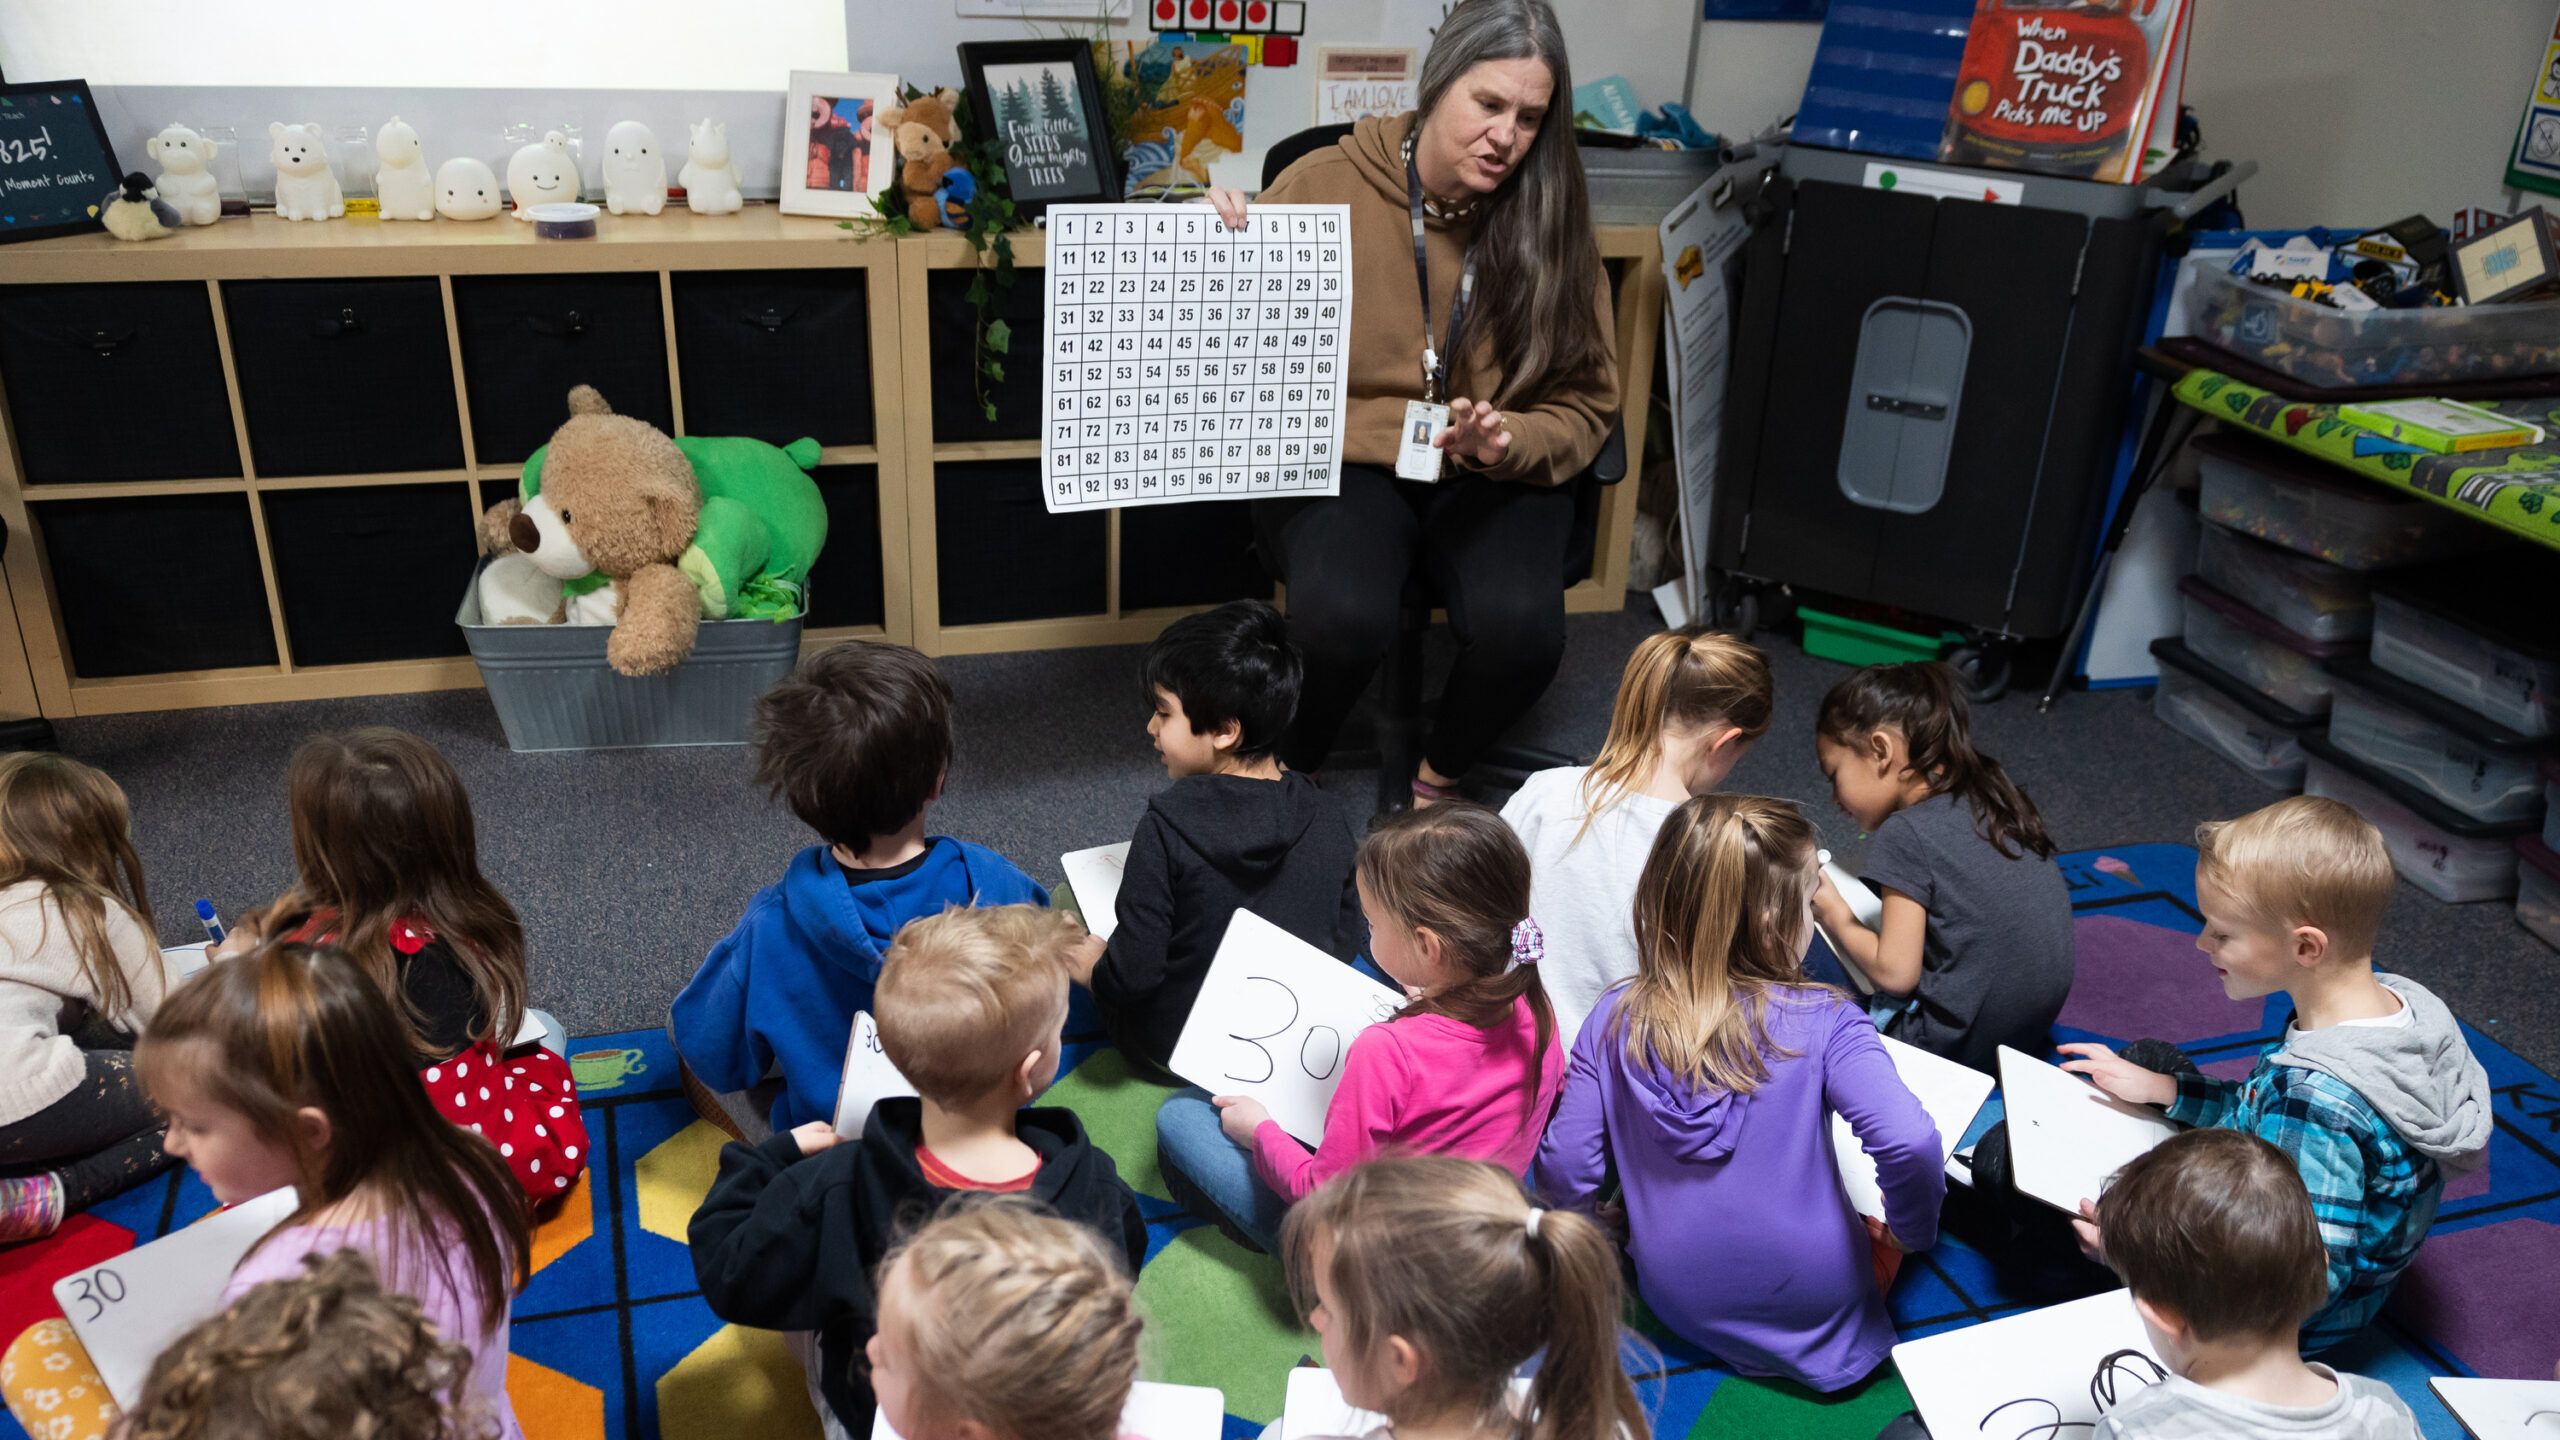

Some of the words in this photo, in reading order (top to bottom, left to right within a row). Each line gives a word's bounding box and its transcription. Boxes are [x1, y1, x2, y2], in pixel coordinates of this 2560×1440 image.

[2017, 16, 2067, 40] When
[2013, 40, 2122, 84] Daddy's
[2017, 72, 2106, 110] Truck
[1992, 98, 2034, 126] Picks
[1024, 134, 1060, 153] SEEDS
[5, 174, 51, 191] Moment
[1028, 166, 1065, 186] TREES
[1066, 221, 1072, 235] 1
[1095, 221, 1103, 234] 2
[1126, 220, 1134, 234] 3
[1156, 220, 1165, 234] 4
[1187, 220, 1194, 234] 5
[1215, 220, 1223, 234] 6
[1271, 221, 1278, 233] 8
[1299, 221, 1306, 233] 9
[1322, 221, 1335, 233] 10
[1062, 251, 1075, 265] 11
[1090, 250, 1106, 264] 12
[1121, 250, 1137, 264] 13
[1152, 250, 1167, 263] 14
[1182, 250, 1197, 263] 15
[1211, 250, 1226, 263] 16
[1239, 250, 1254, 263] 17
[1269, 249, 1283, 262] 18
[1297, 249, 1311, 262] 19
[1323, 249, 1337, 262] 20
[1061, 281, 1075, 295] 21
[1089, 280, 1105, 294] 22
[1119, 280, 1136, 293] 23
[1150, 279, 1166, 293] 24
[1180, 279, 1195, 292] 25
[1209, 279, 1224, 292] 26
[1237, 279, 1253, 292] 27
[1267, 278, 1282, 292] 28
[1296, 278, 1311, 291] 29
[1323, 278, 1337, 291] 30
[1060, 311, 1074, 325] 31
[1088, 310, 1104, 324] 32
[1118, 309, 1134, 322] 33
[1149, 308, 1164, 322] 34
[1178, 308, 1194, 321] 35
[1207, 308, 1222, 321] 36
[1236, 308, 1251, 320] 37
[1265, 307, 1281, 320] 38
[1294, 306, 1309, 320] 39
[1321, 306, 1336, 319] 40
[1059, 340, 1073, 354] 41
[1087, 339, 1103, 352] 42
[1117, 338, 1133, 351] 43
[1147, 337, 1163, 350] 44
[1176, 336, 1192, 349] 45
[1205, 336, 1221, 349] 46
[1233, 336, 1249, 348] 47
[1263, 335, 1278, 348] 48
[1291, 334, 1307, 347] 49
[1319, 334, 1333, 347] 50
[1059, 369, 1072, 382] 51
[1087, 367, 1102, 381] 52
[1116, 366, 1132, 379] 53
[1146, 365, 1161, 378] 54
[1175, 364, 1190, 377] 55
[1204, 364, 1219, 377] 56
[1232, 363, 1247, 376] 57
[1261, 362, 1276, 375] 58
[1290, 362, 1305, 374] 59
[1317, 361, 1332, 374] 60
[1058, 397, 1072, 411] 61
[1086, 396, 1101, 409] 62
[1115, 394, 1131, 408] 63
[1145, 393, 1160, 406] 64
[1174, 392, 1189, 405] 65
[1202, 391, 1217, 404] 66
[1230, 391, 1245, 403] 67
[1259, 390, 1274, 402] 68
[1288, 389, 1303, 402] 69
[1316, 388, 1330, 401] 70
[1058, 425, 1071, 439] 71
[1086, 424, 1101, 437] 72
[1115, 422, 1130, 436] 73
[1144, 421, 1159, 434] 74
[1173, 419, 1187, 433] 75
[1201, 418, 1216, 431] 76
[1229, 418, 1244, 430] 77
[1258, 417, 1273, 430] 78
[1287, 416, 1302, 429] 79
[1314, 416, 1329, 428] 80
[1057, 454, 1071, 467] 81
[1085, 452, 1100, 465] 82
[1114, 450, 1129, 463] 83
[1143, 448, 1158, 461] 84
[1172, 447, 1186, 460] 85
[1199, 446, 1214, 458] 86
[1227, 445, 1242, 457] 87
[1256, 444, 1271, 457] 88
[1285, 443, 1300, 456] 89
[1313, 443, 1327, 455] 90
[1058, 482, 1072, 495] 91
[1085, 479, 1100, 493] 92
[1114, 478, 1129, 491] 93
[1142, 475, 1157, 488] 94
[1171, 474, 1185, 487] 95
[1198, 472, 1213, 485] 96
[1226, 472, 1241, 484] 97
[1255, 471, 1270, 483] 98
[1283, 469, 1298, 482] 99
[1307, 468, 1328, 480] 100
[1224, 976, 1340, 1083] 30
[68, 1269, 125, 1323] 30
